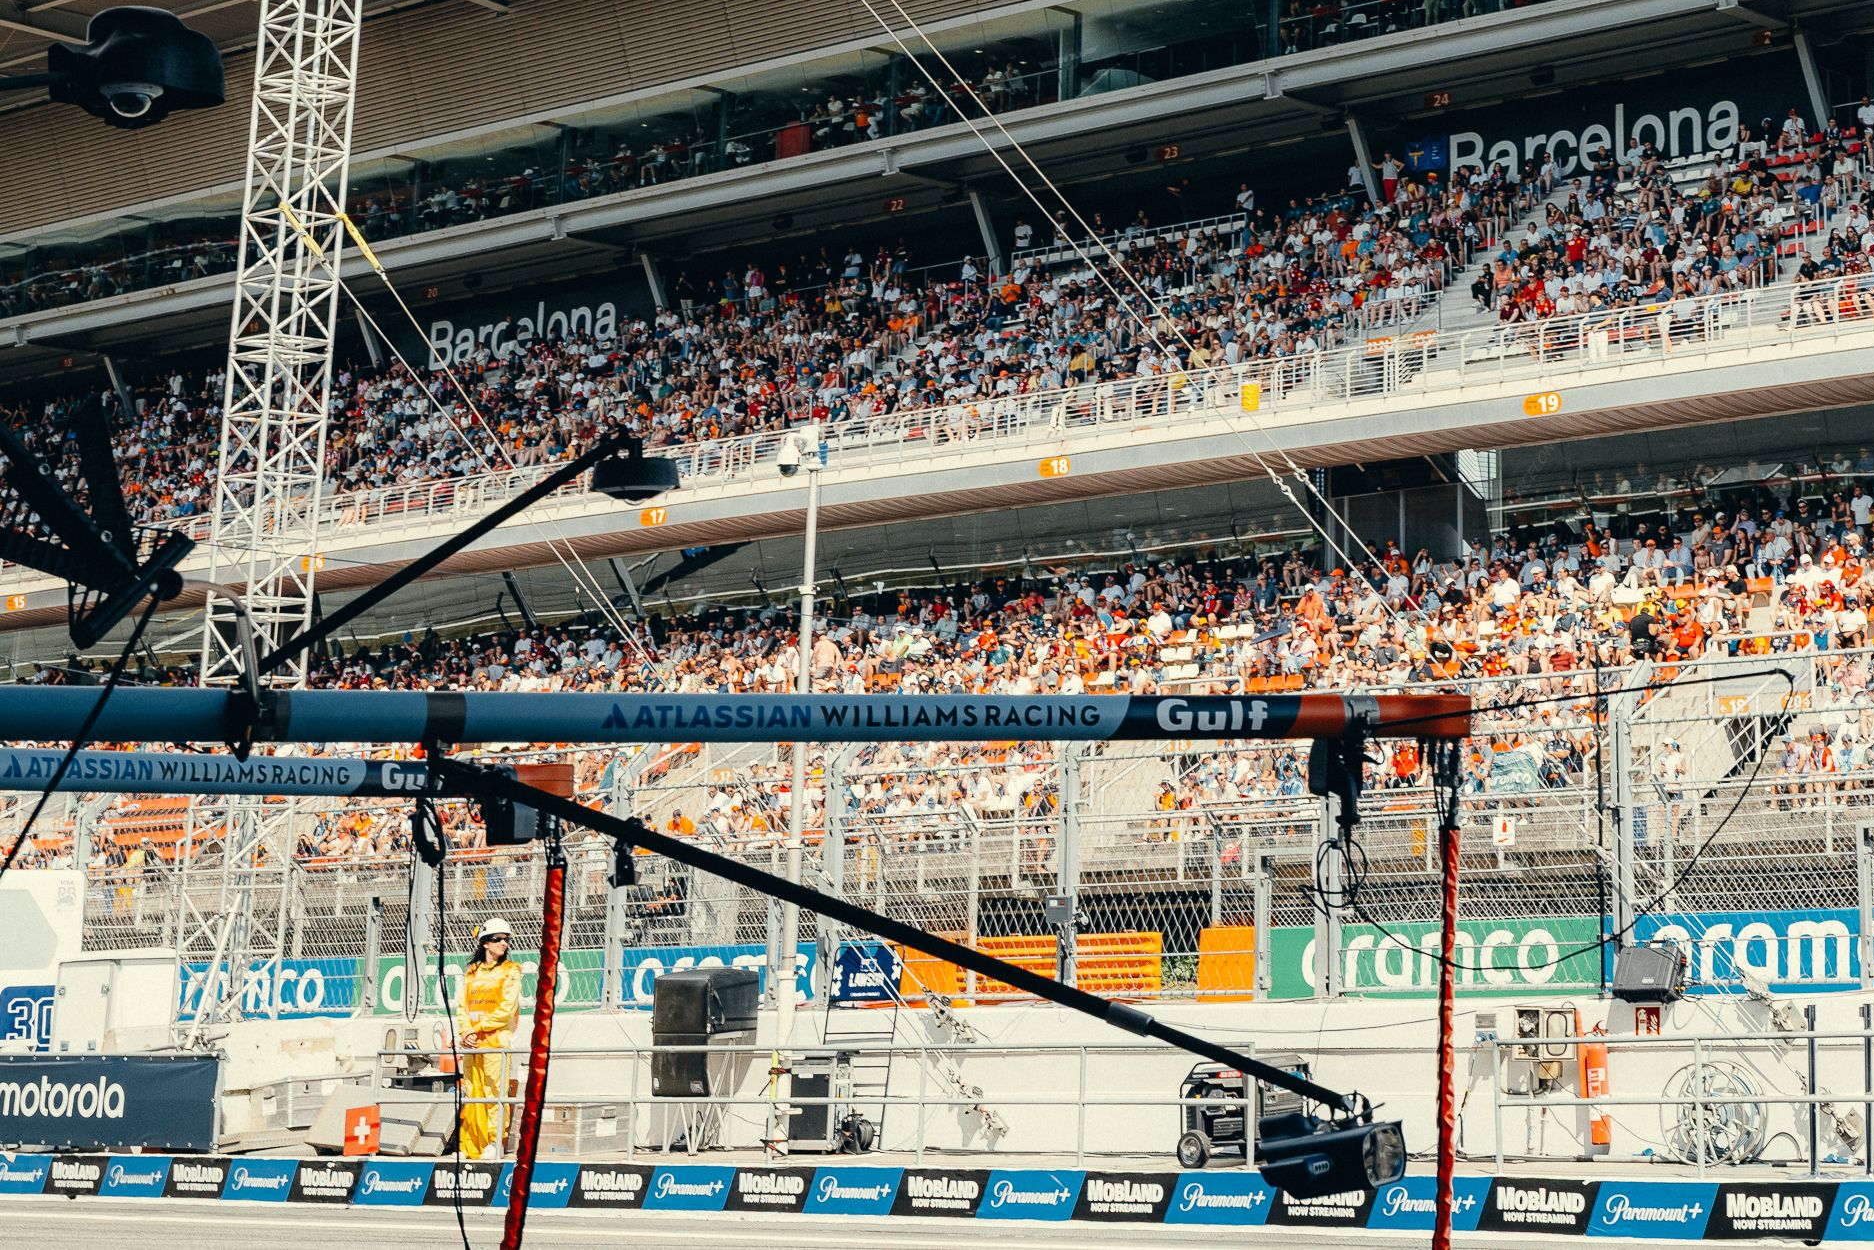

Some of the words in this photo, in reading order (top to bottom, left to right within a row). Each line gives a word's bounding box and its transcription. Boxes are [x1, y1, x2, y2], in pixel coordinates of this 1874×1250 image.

[1434, 94, 1449, 106] 24
[1164, 146, 1178, 159] 23
[1450, 100, 1739, 183] Barcelona
[891, 200, 903, 211] 22
[1537, 394, 1559, 412] 19
[1050, 458, 1068, 474] 18
[650, 509, 665, 524] 17
[13, 595, 25, 608] 15
[633, 704, 812, 730] ATLASSIAN
[1156, 698, 1268, 732] Gulf
[0, 1075, 125, 1119] motorola
[52, 1162, 100, 1184] MOBLAND
[109, 1165, 162, 1190] Paramount+
[173, 1163, 224, 1184] MOBLAND
[234, 1166, 288, 1191] Paramount+
[301, 1167, 353, 1188] MOBLAND
[361, 1168, 423, 1195] Paramount+
[581, 1171, 642, 1192] MOBLAND
[739, 1173, 804, 1195] MOBLAND
[657, 1173, 723, 1199] Paramount+
[817, 1176, 891, 1203] Paramount+
[908, 1176, 979, 1199] MOBLAND
[991, 1180, 1071, 1208] Paramount+
[1088, 1180, 1164, 1203] MOBLAND
[1180, 1183, 1266, 1212] Paramount+
[1497, 1187, 1586, 1213] MOBLAND
[1603, 1194, 1703, 1225] Paramount+
[1727, 1193, 1822, 1218] MOBLAND
